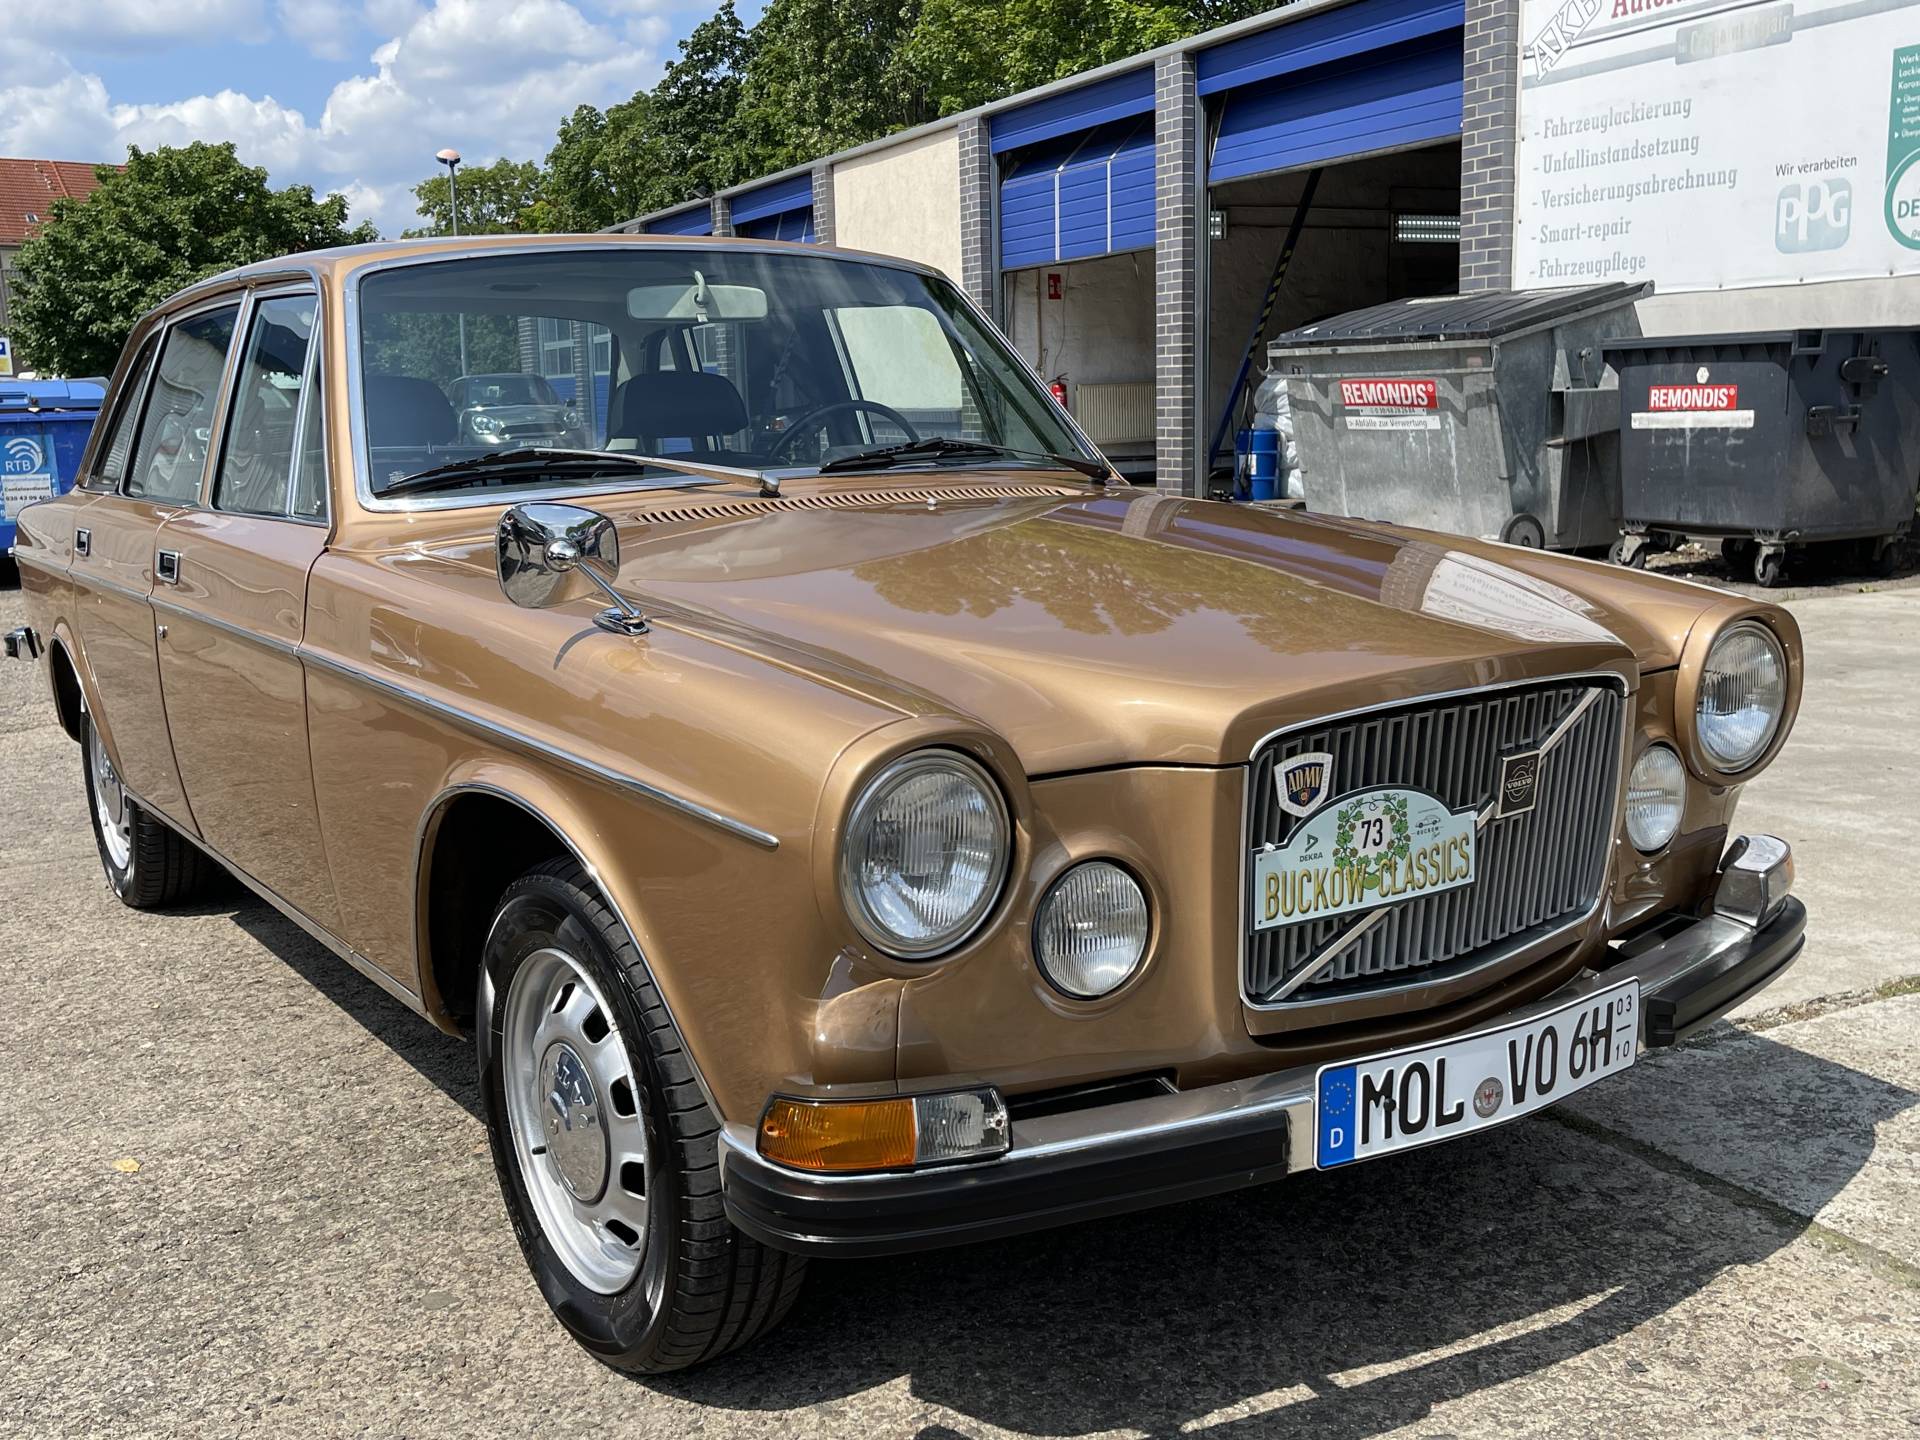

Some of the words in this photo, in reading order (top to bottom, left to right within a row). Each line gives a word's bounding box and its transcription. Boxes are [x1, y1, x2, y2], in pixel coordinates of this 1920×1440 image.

[1544, 98, 1692, 139] Fahrzeuglackierung
[1543, 135, 1700, 174] Unfallinstandsetzung
[1776, 163, 1794, 176] Wir
[1798, 156, 1857, 174] verarbeiten
[1541, 168, 1738, 209] Versicherungsabrechnung
[1779, 180, 1848, 240] PPG
[1540, 216, 1632, 244] Smart-repair
[1538, 251, 1646, 279] Fahrzeugpflege
[5, 461, 31, 472] RTB
[1288, 767, 1323, 794] ADMV
[1507, 778, 1532, 789] VOLVO
[1361, 818, 1383, 849] 73
[1299, 853, 1323, 863] DEKRA
[1265, 863, 1366, 921] BUCKOW
[1378, 831, 1470, 898] CLASSICS
[1616, 994, 1632, 1016] 03
[1616, 1040, 1630, 1061] 10
[1330, 1128, 1344, 1149] D
[1361, 1057, 1464, 1145] MOL
[1508, 1025, 1558, 1105] VO
[1569, 1002, 1614, 1079] 6H
